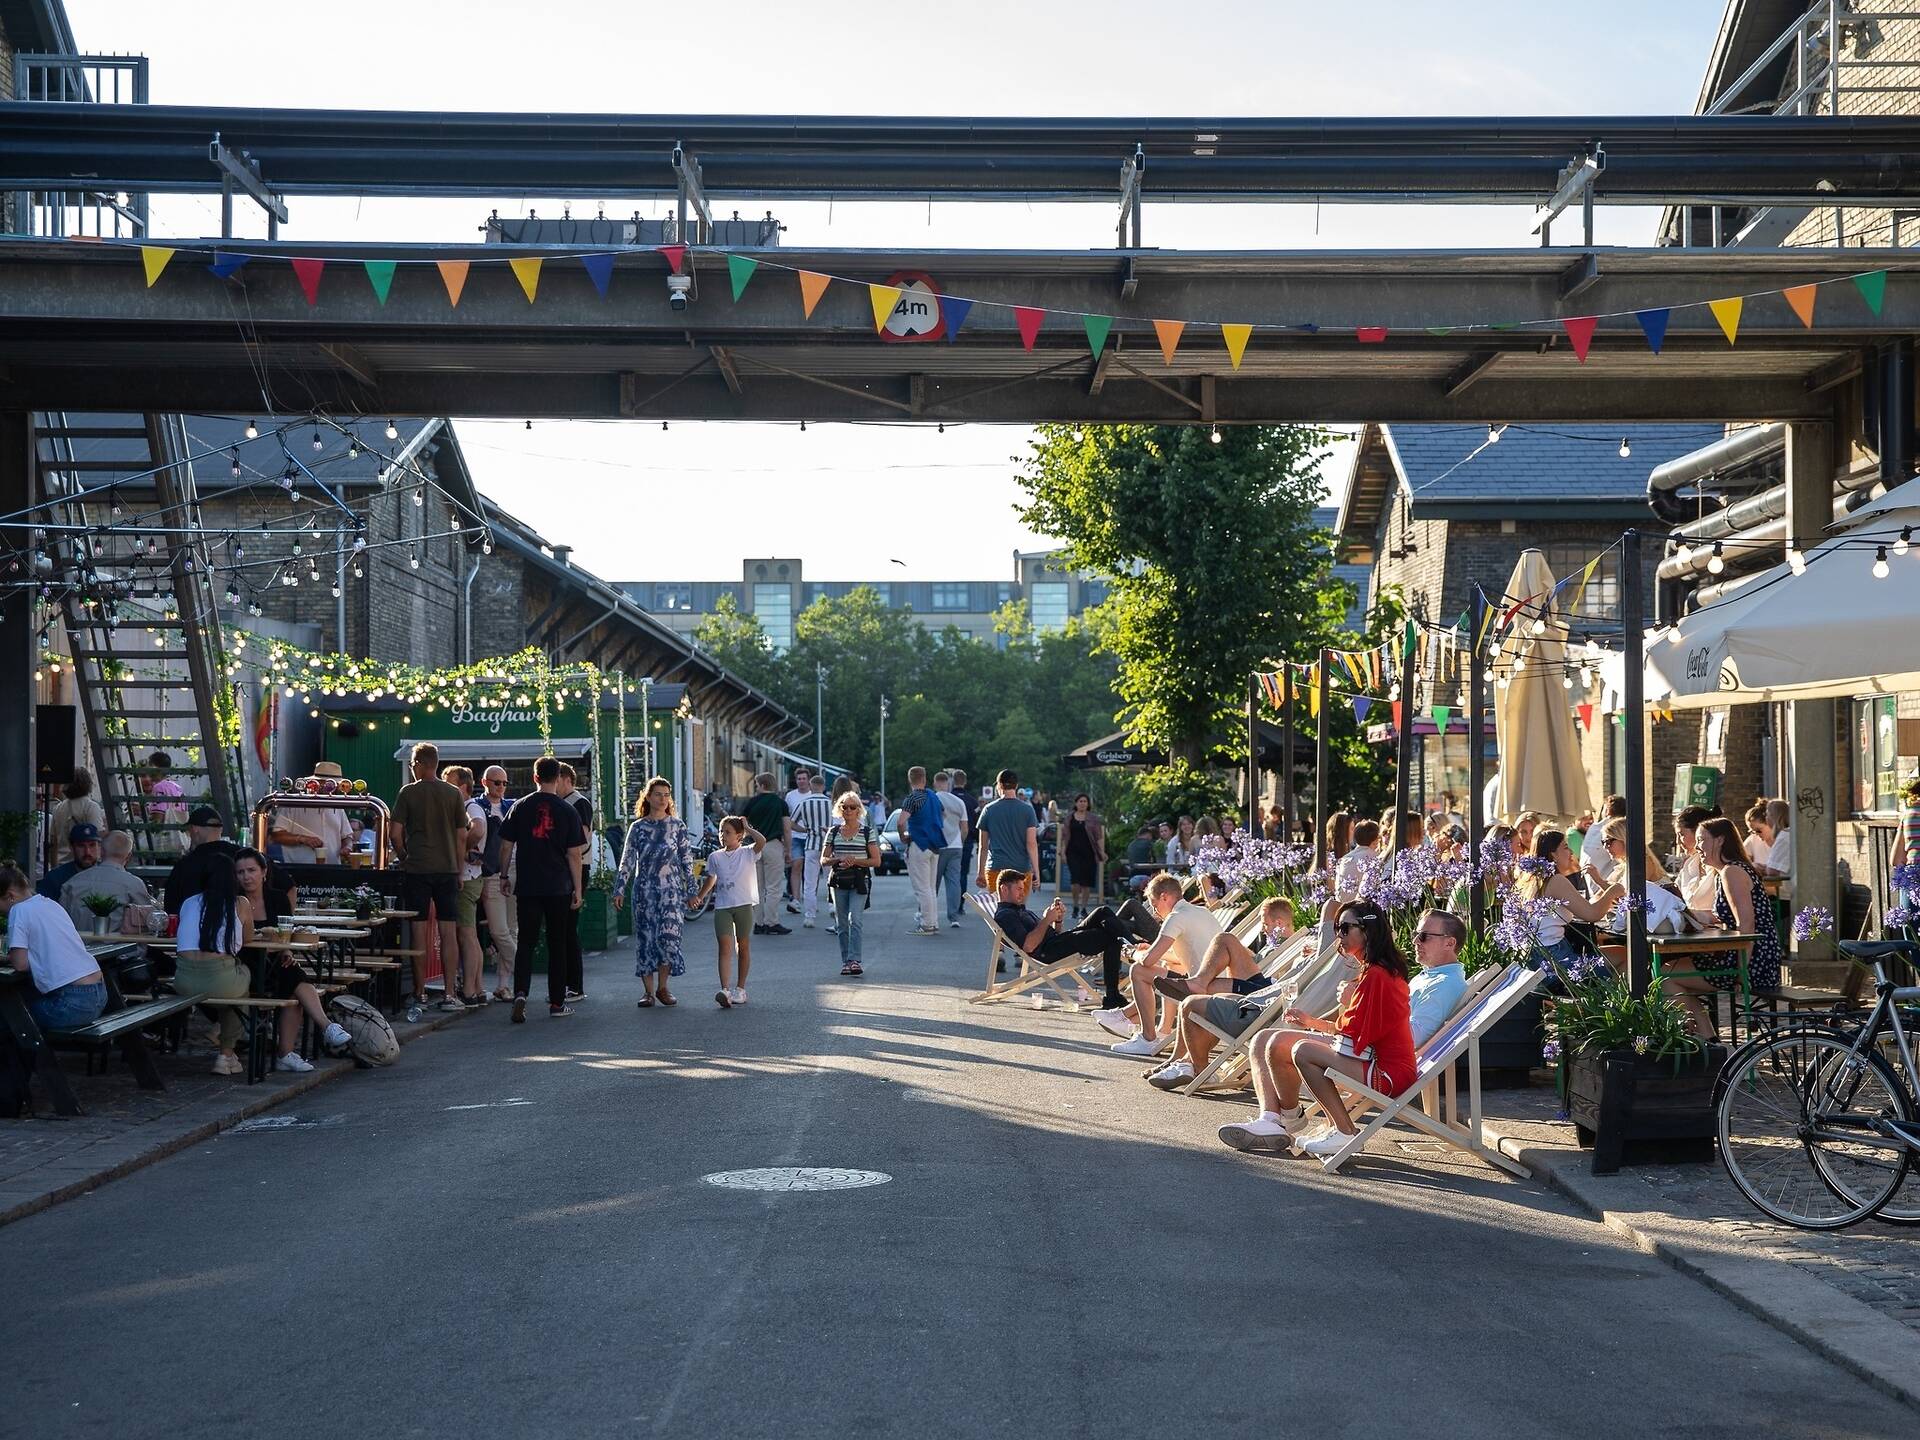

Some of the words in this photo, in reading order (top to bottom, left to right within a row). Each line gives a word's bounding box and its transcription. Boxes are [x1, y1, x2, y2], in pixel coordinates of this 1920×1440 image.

[895, 299, 928, 315] 4m
[1096, 750, 1132, 763] Carlsberg
[295, 885, 311, 895] rink
